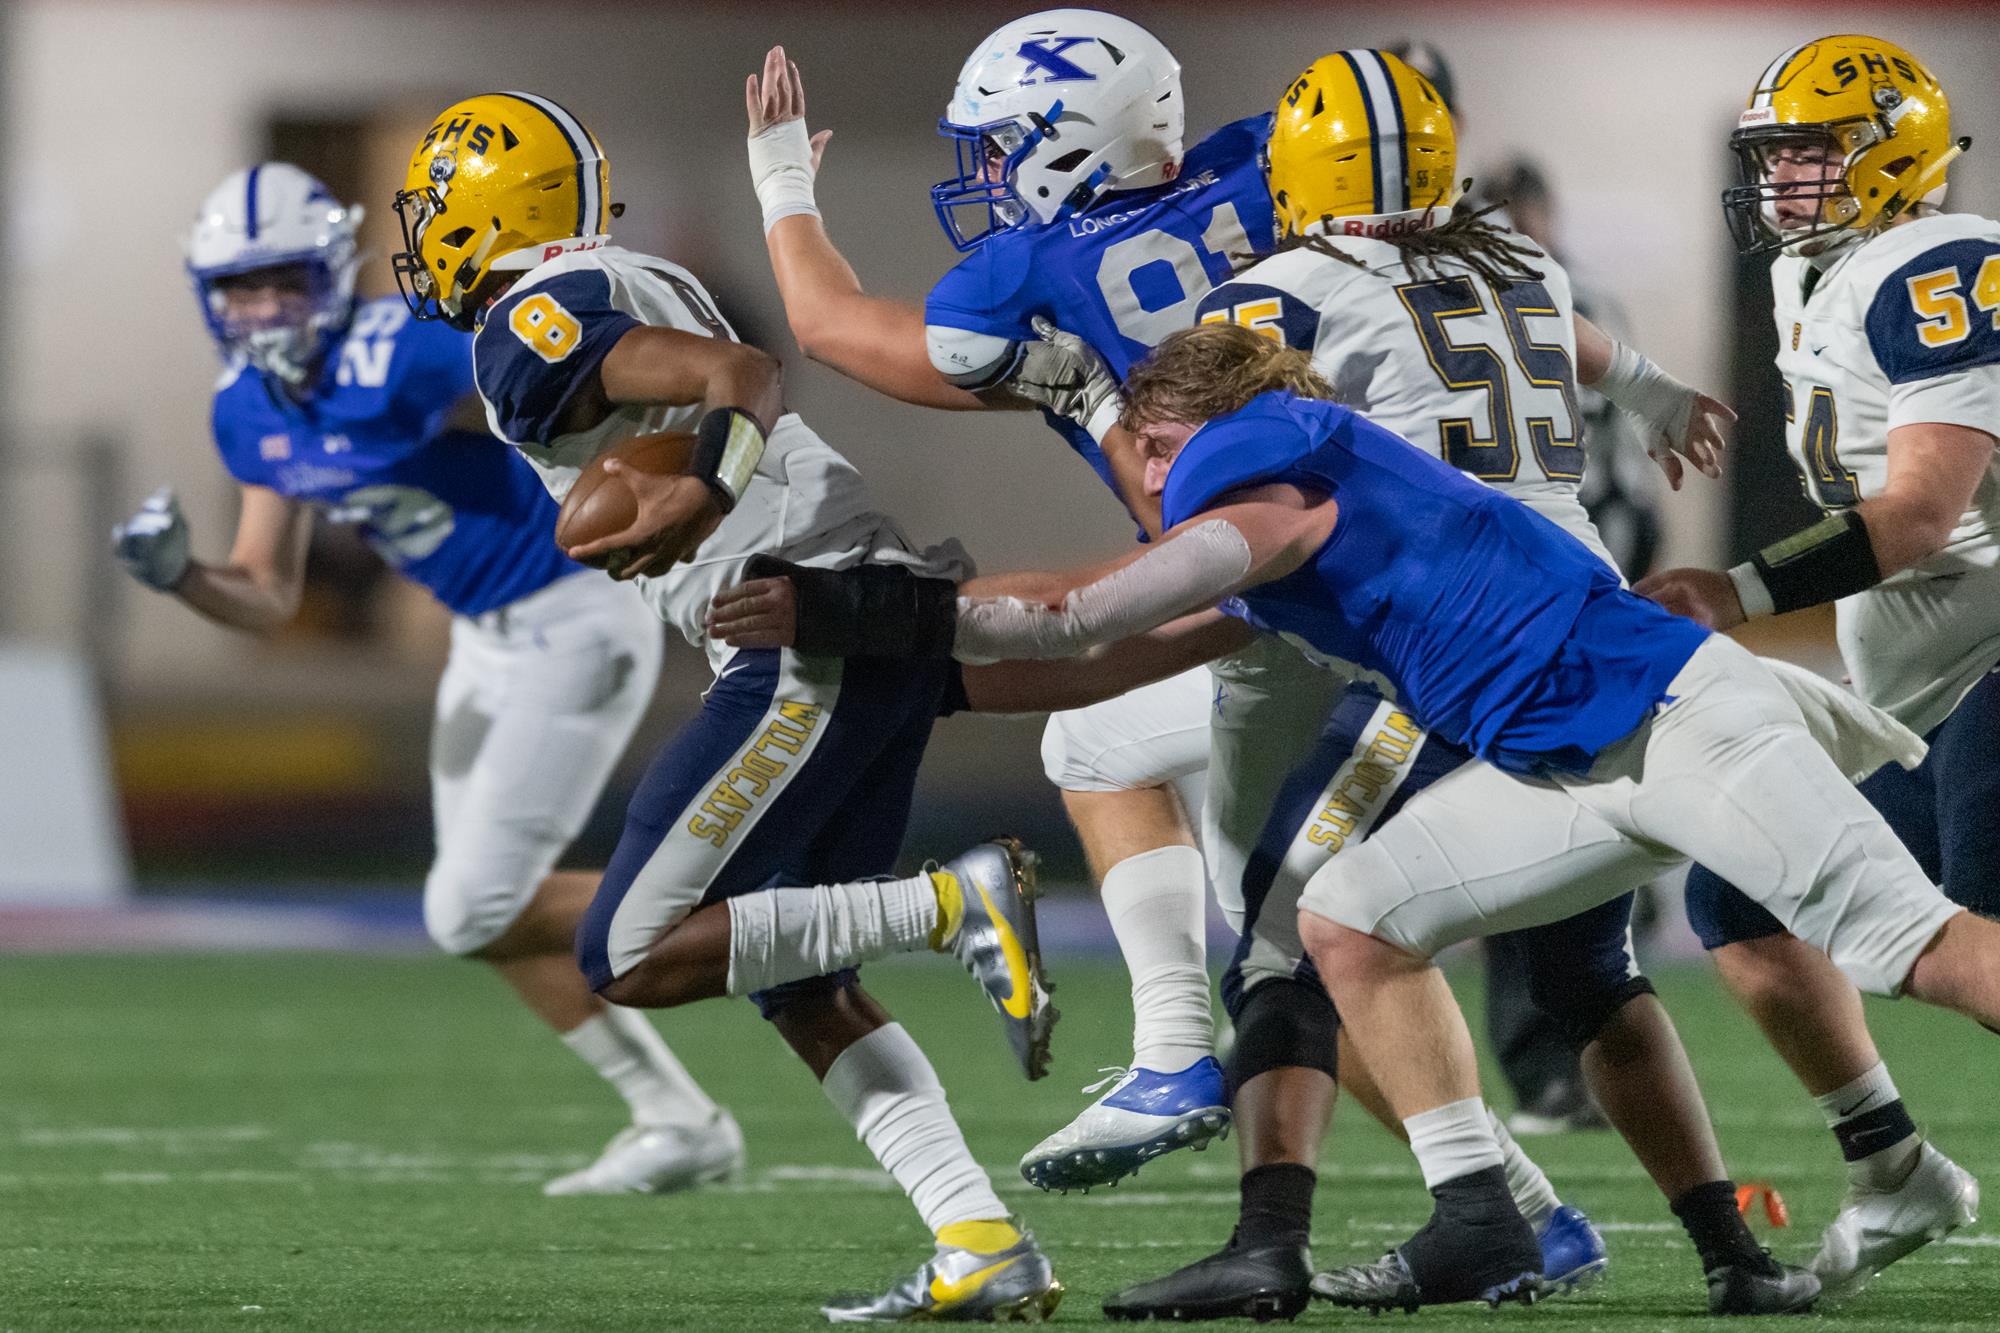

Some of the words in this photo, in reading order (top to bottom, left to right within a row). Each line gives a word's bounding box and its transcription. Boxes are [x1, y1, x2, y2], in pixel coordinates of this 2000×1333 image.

[1017, 36, 1097, 86] X
[1832, 53, 1917, 88] SHS
[420, 117, 496, 156] SHS
[1068, 212, 1128, 239] LONG
[1343, 211, 1435, 240] Riddel
[509, 292, 583, 374] 8
[1393, 273, 1589, 483] 55
[1782, 379, 1863, 510] 4
[687, 699, 824, 849] WILDCATS
[1306, 710, 1422, 854] WILDCATS
